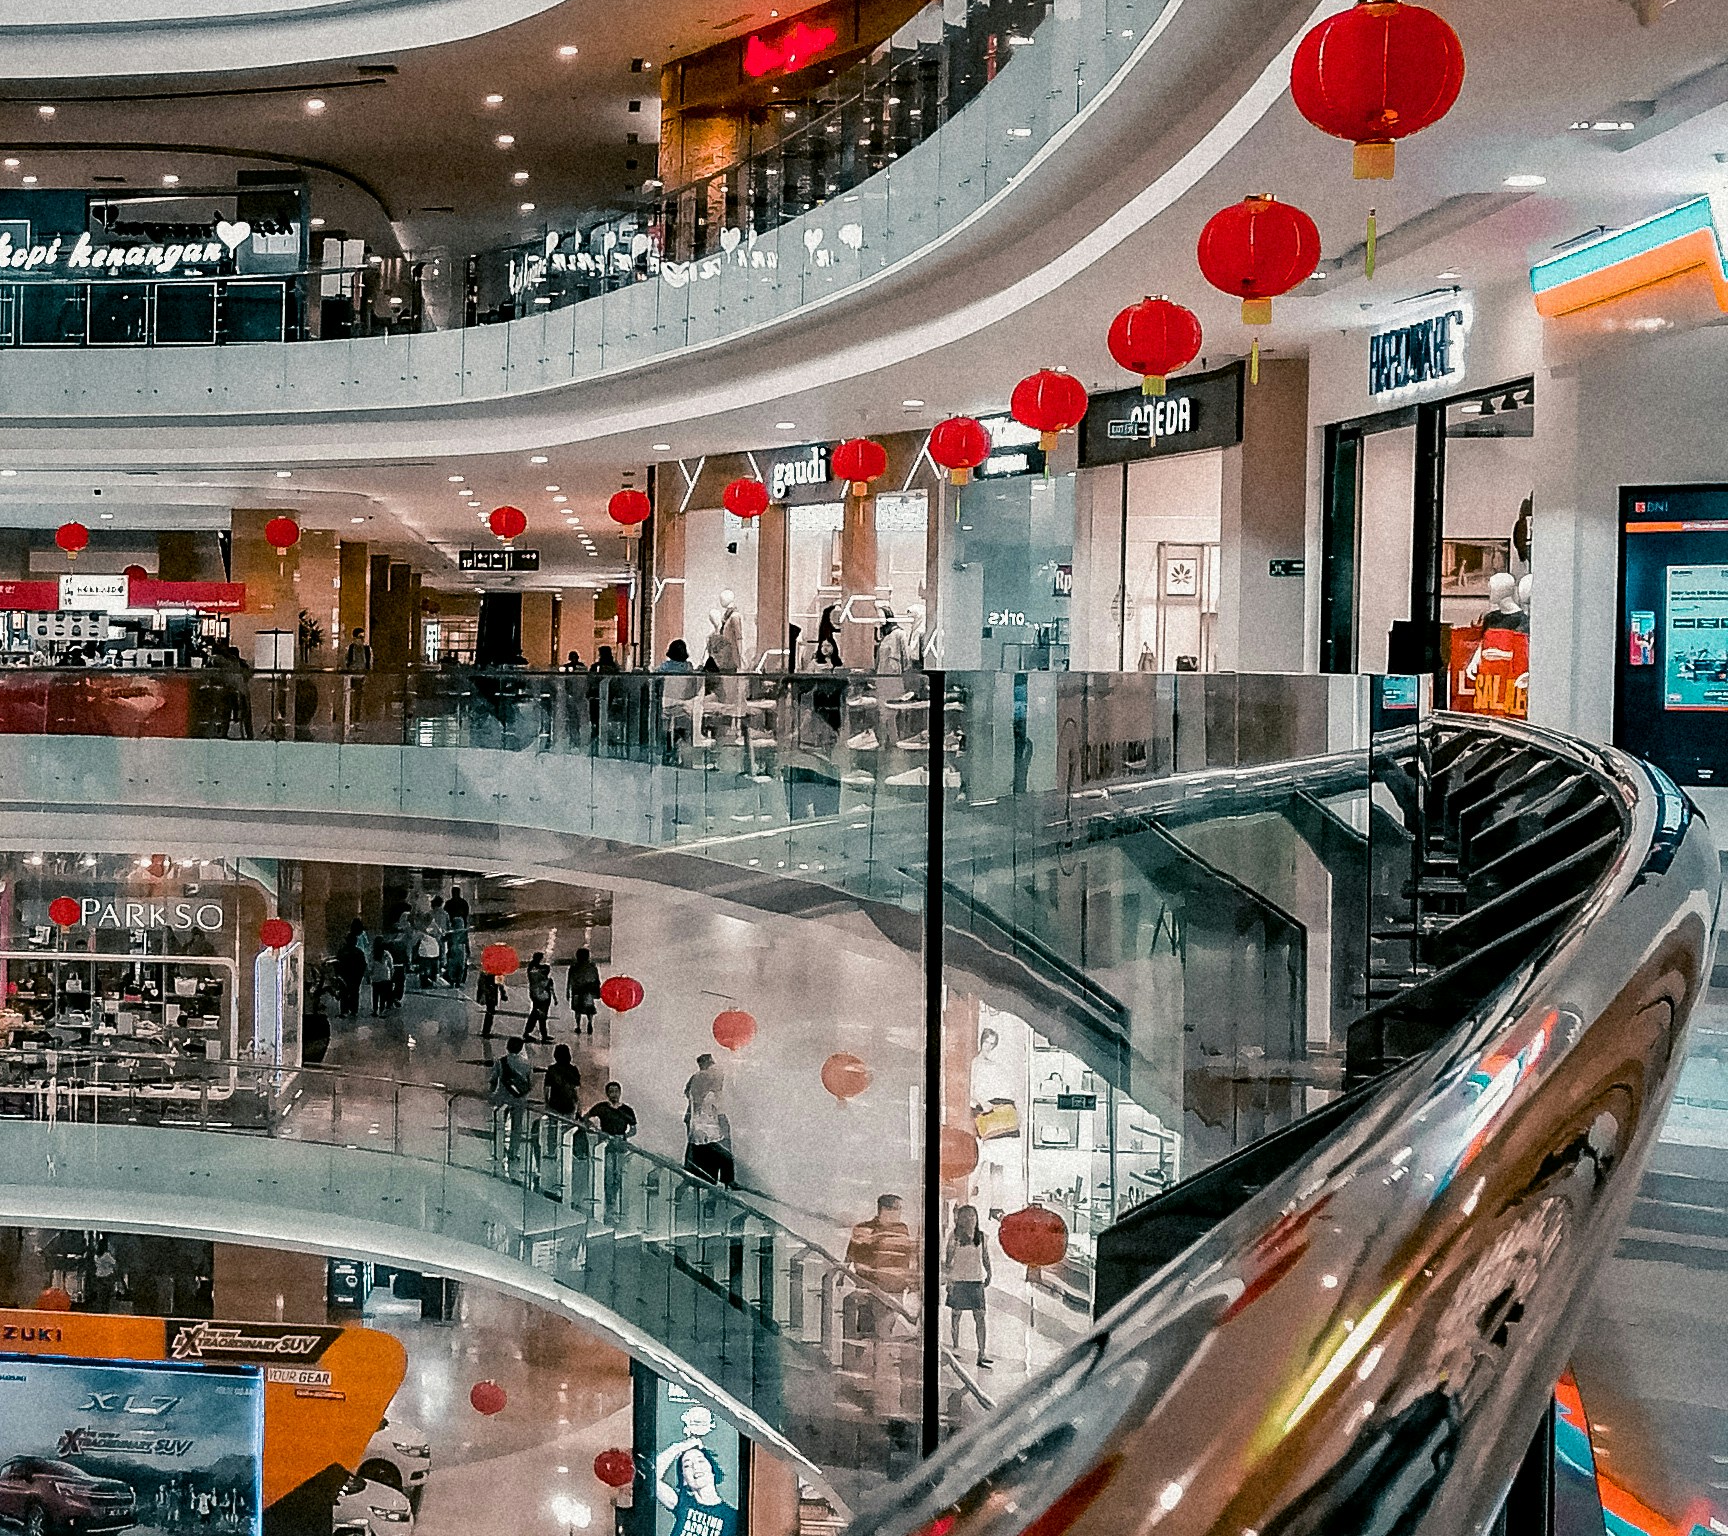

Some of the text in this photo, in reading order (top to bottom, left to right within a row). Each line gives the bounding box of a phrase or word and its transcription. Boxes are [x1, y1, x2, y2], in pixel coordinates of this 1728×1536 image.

[69, 232, 222, 273] kenangan
[772, 448, 826, 497] gaudi
[277, 1334, 322, 1354] SUV
[298, 1371, 330, 1385] GEAR
